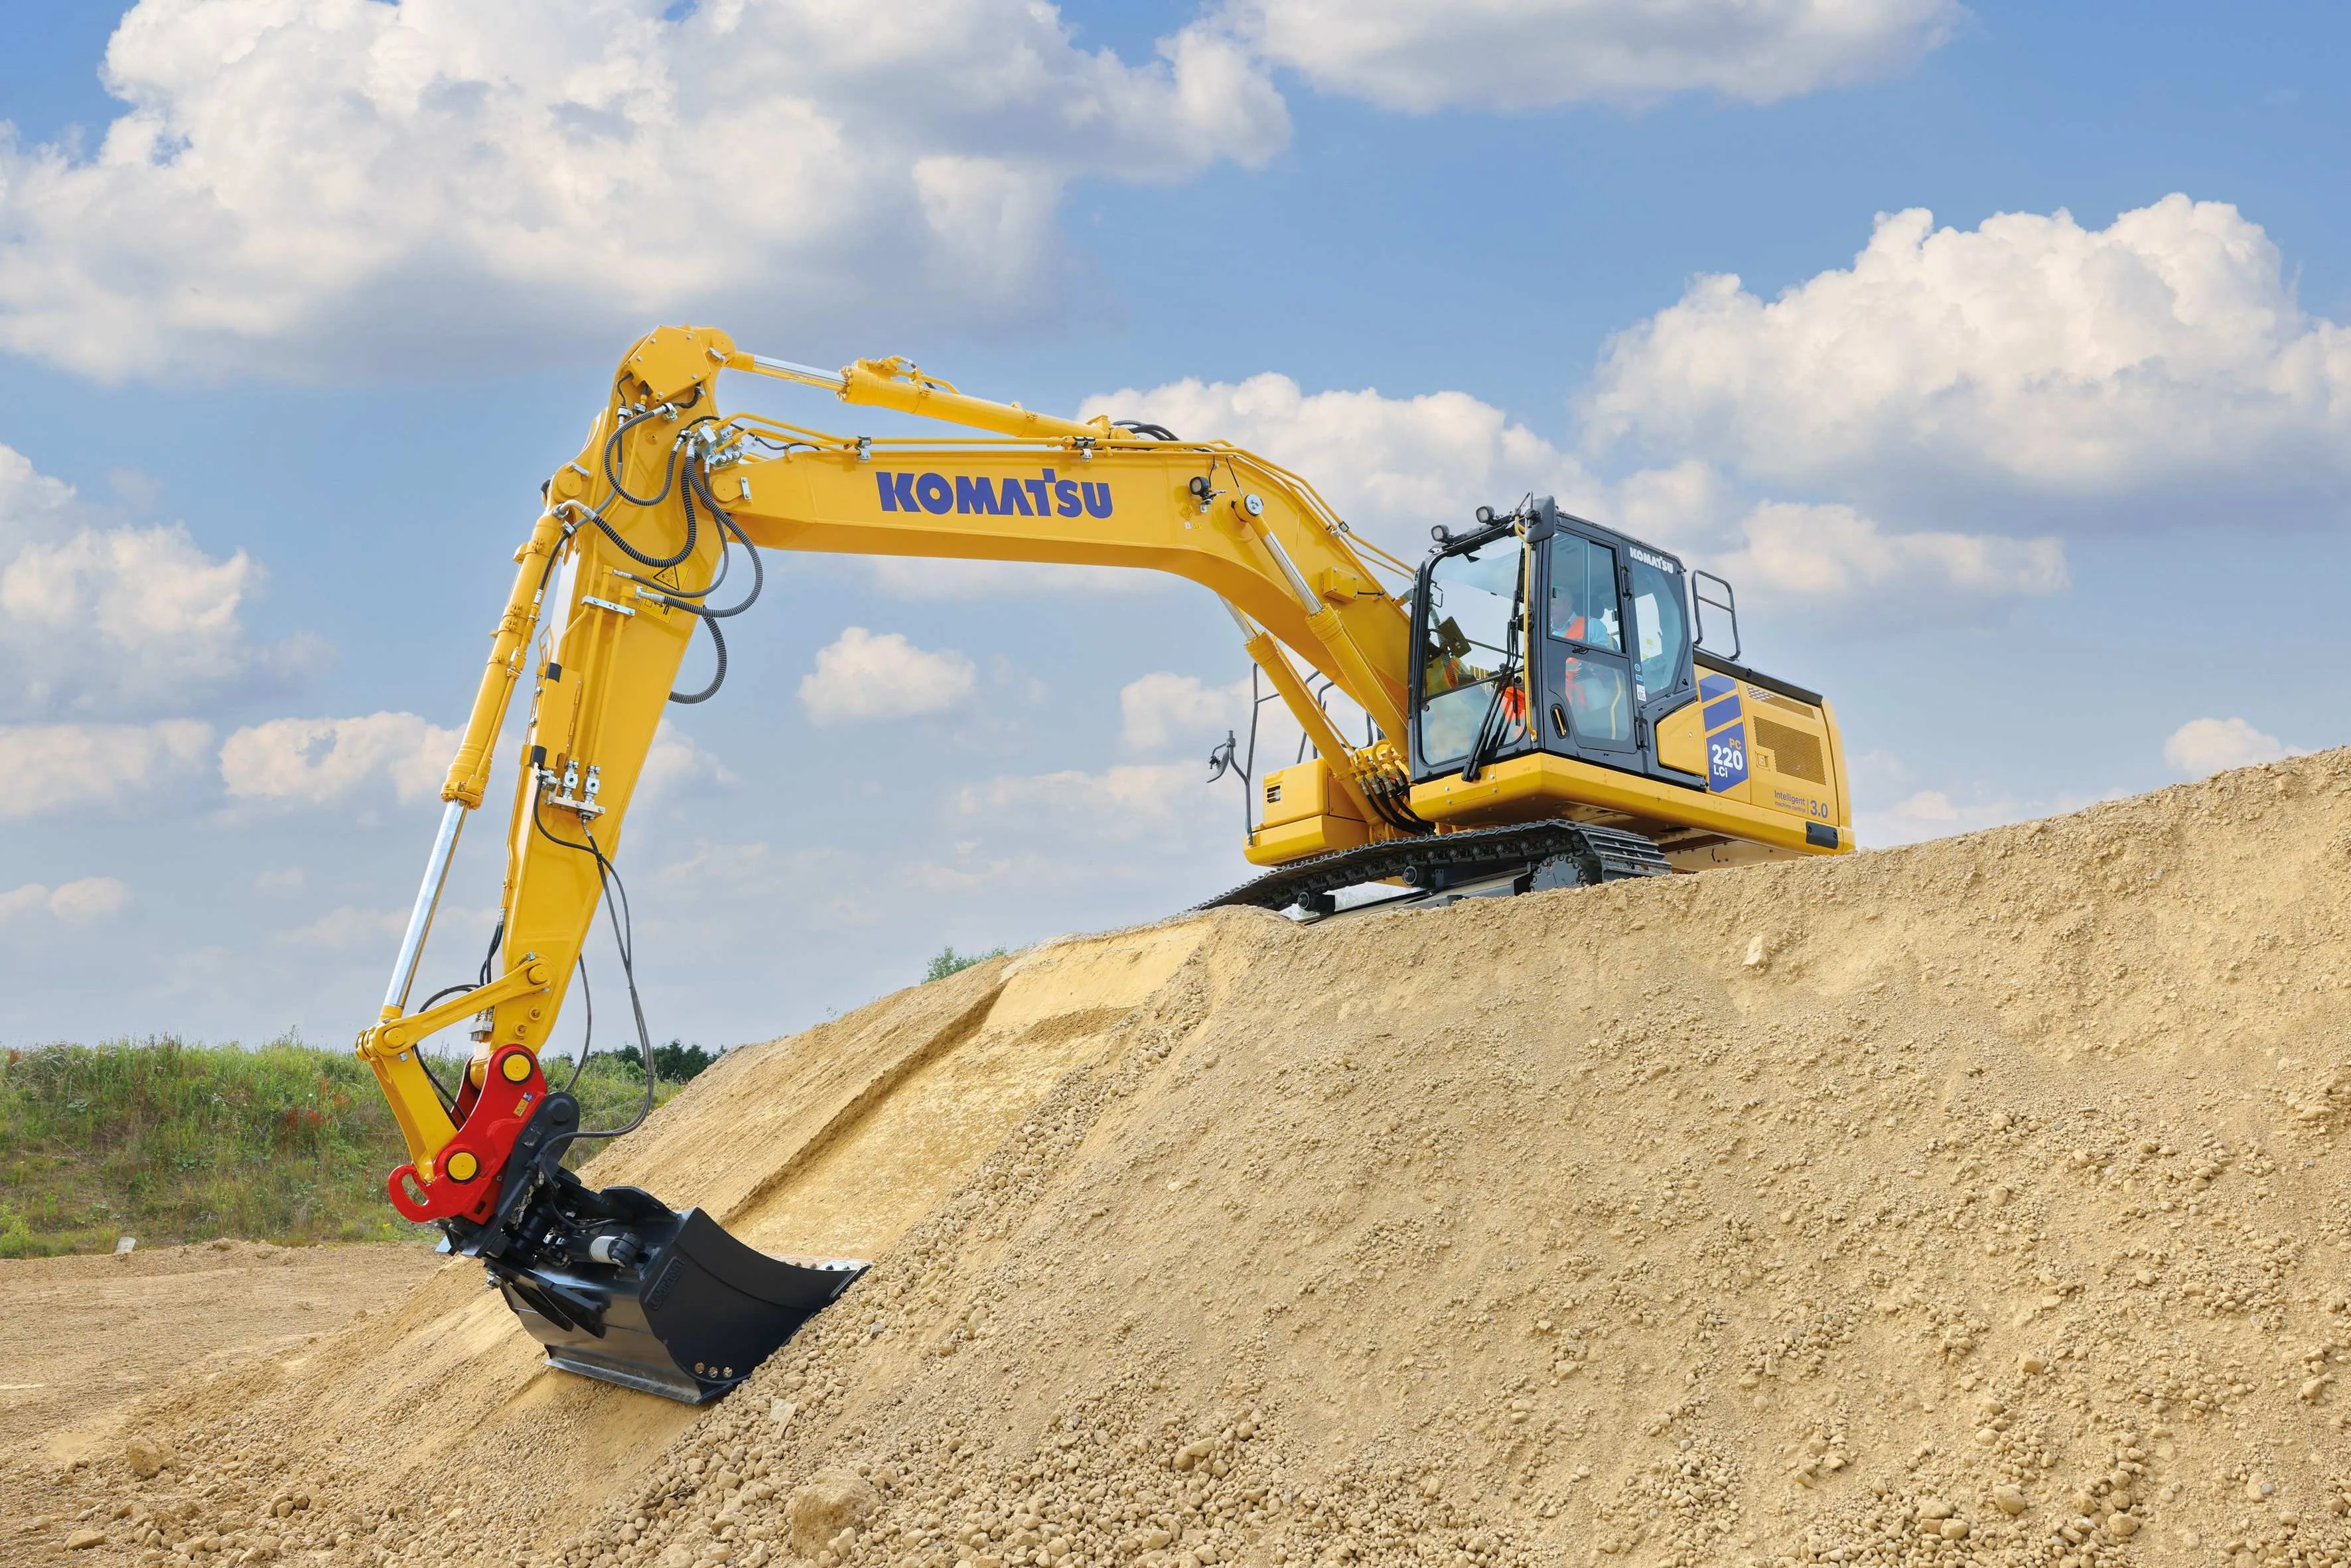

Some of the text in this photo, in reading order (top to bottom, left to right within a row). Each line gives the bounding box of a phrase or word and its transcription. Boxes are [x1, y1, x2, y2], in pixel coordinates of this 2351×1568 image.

[876, 468, 1113, 519] KOMATSU
[1630, 547, 1674, 574] KOMATSU
[1729, 738, 1742, 750] PC
[1712, 744, 1743, 770] 220
[1714, 764, 1728, 778] LCi
[1774, 790, 1806, 805] Intelligent
[1810, 800, 1827, 818] 3.0
